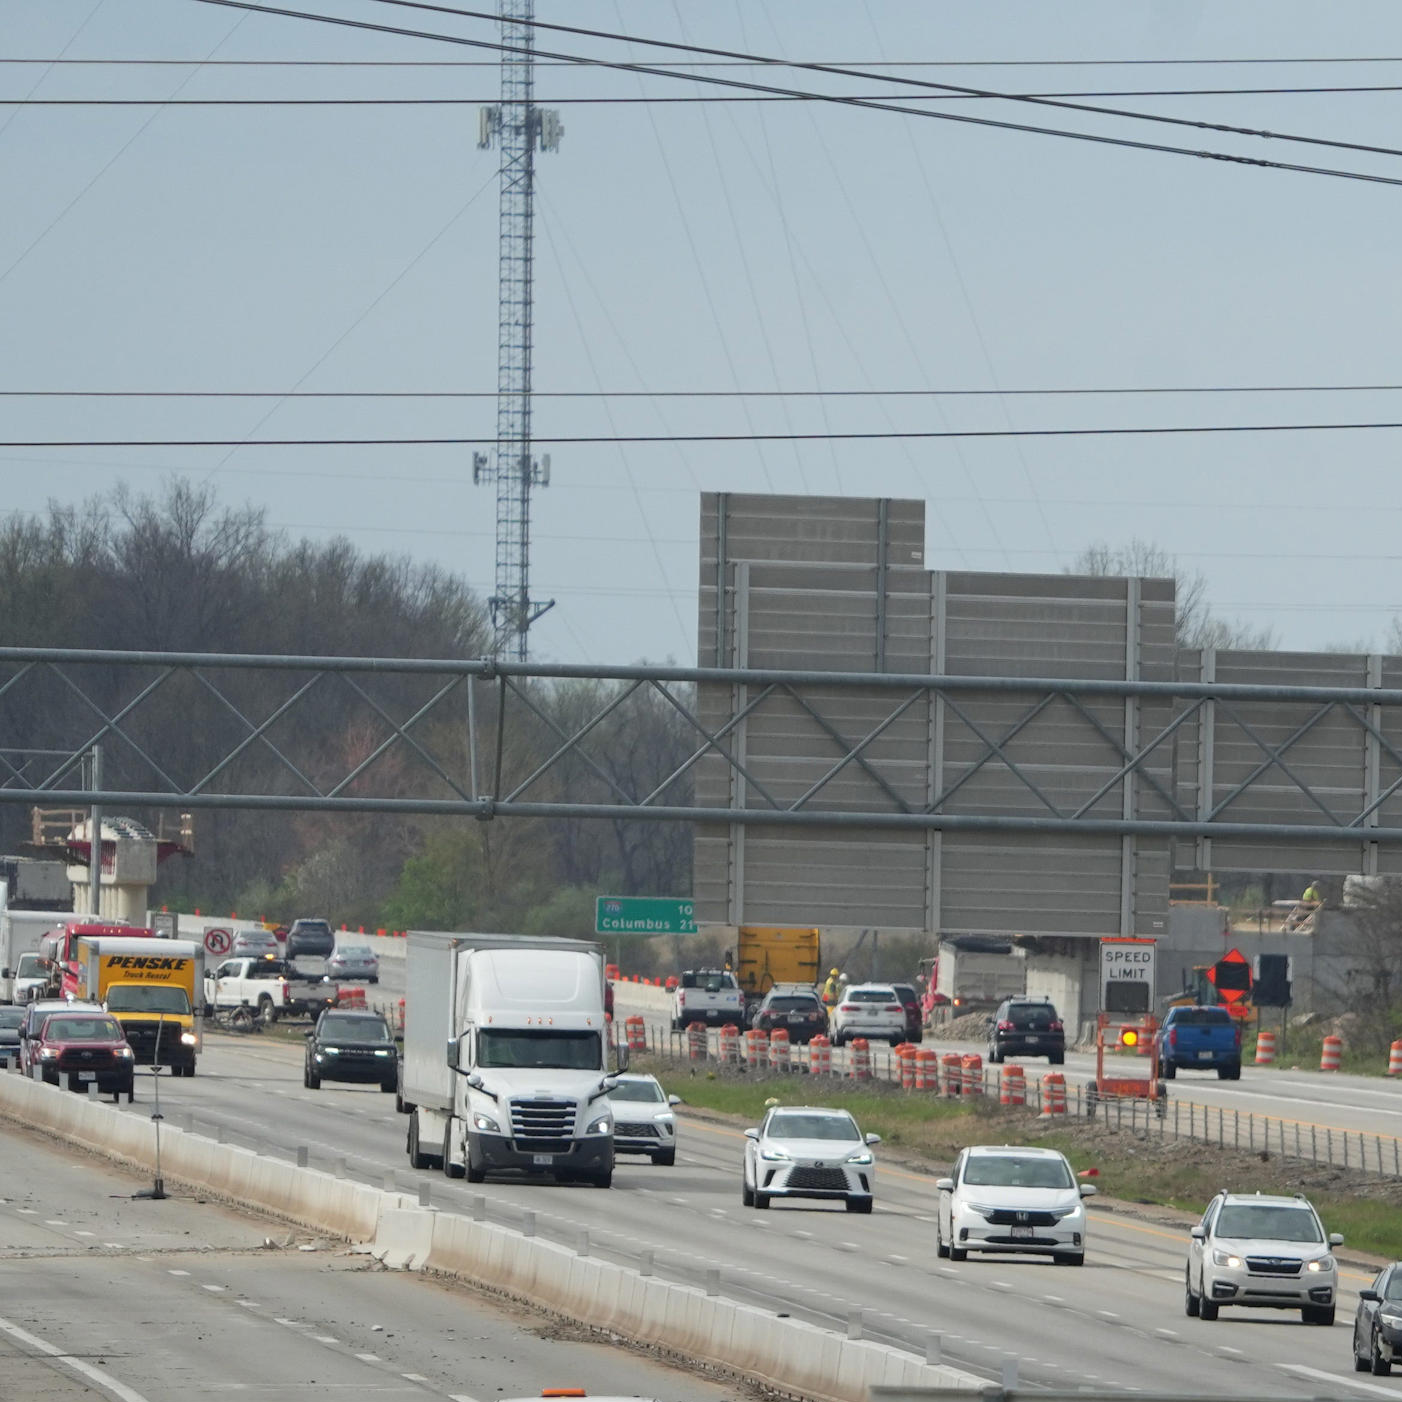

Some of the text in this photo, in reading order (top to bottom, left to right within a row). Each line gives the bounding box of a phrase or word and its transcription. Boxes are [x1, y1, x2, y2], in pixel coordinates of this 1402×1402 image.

[678, 905, 693, 915] 10
[602, 917, 670, 930] Columbus
[1105, 951, 1151, 963] SPEED
[106, 956, 188, 971] PENSKE
[123, 970, 171, 980] Truck Rental
[1109, 968, 1145, 979] LIMIT
